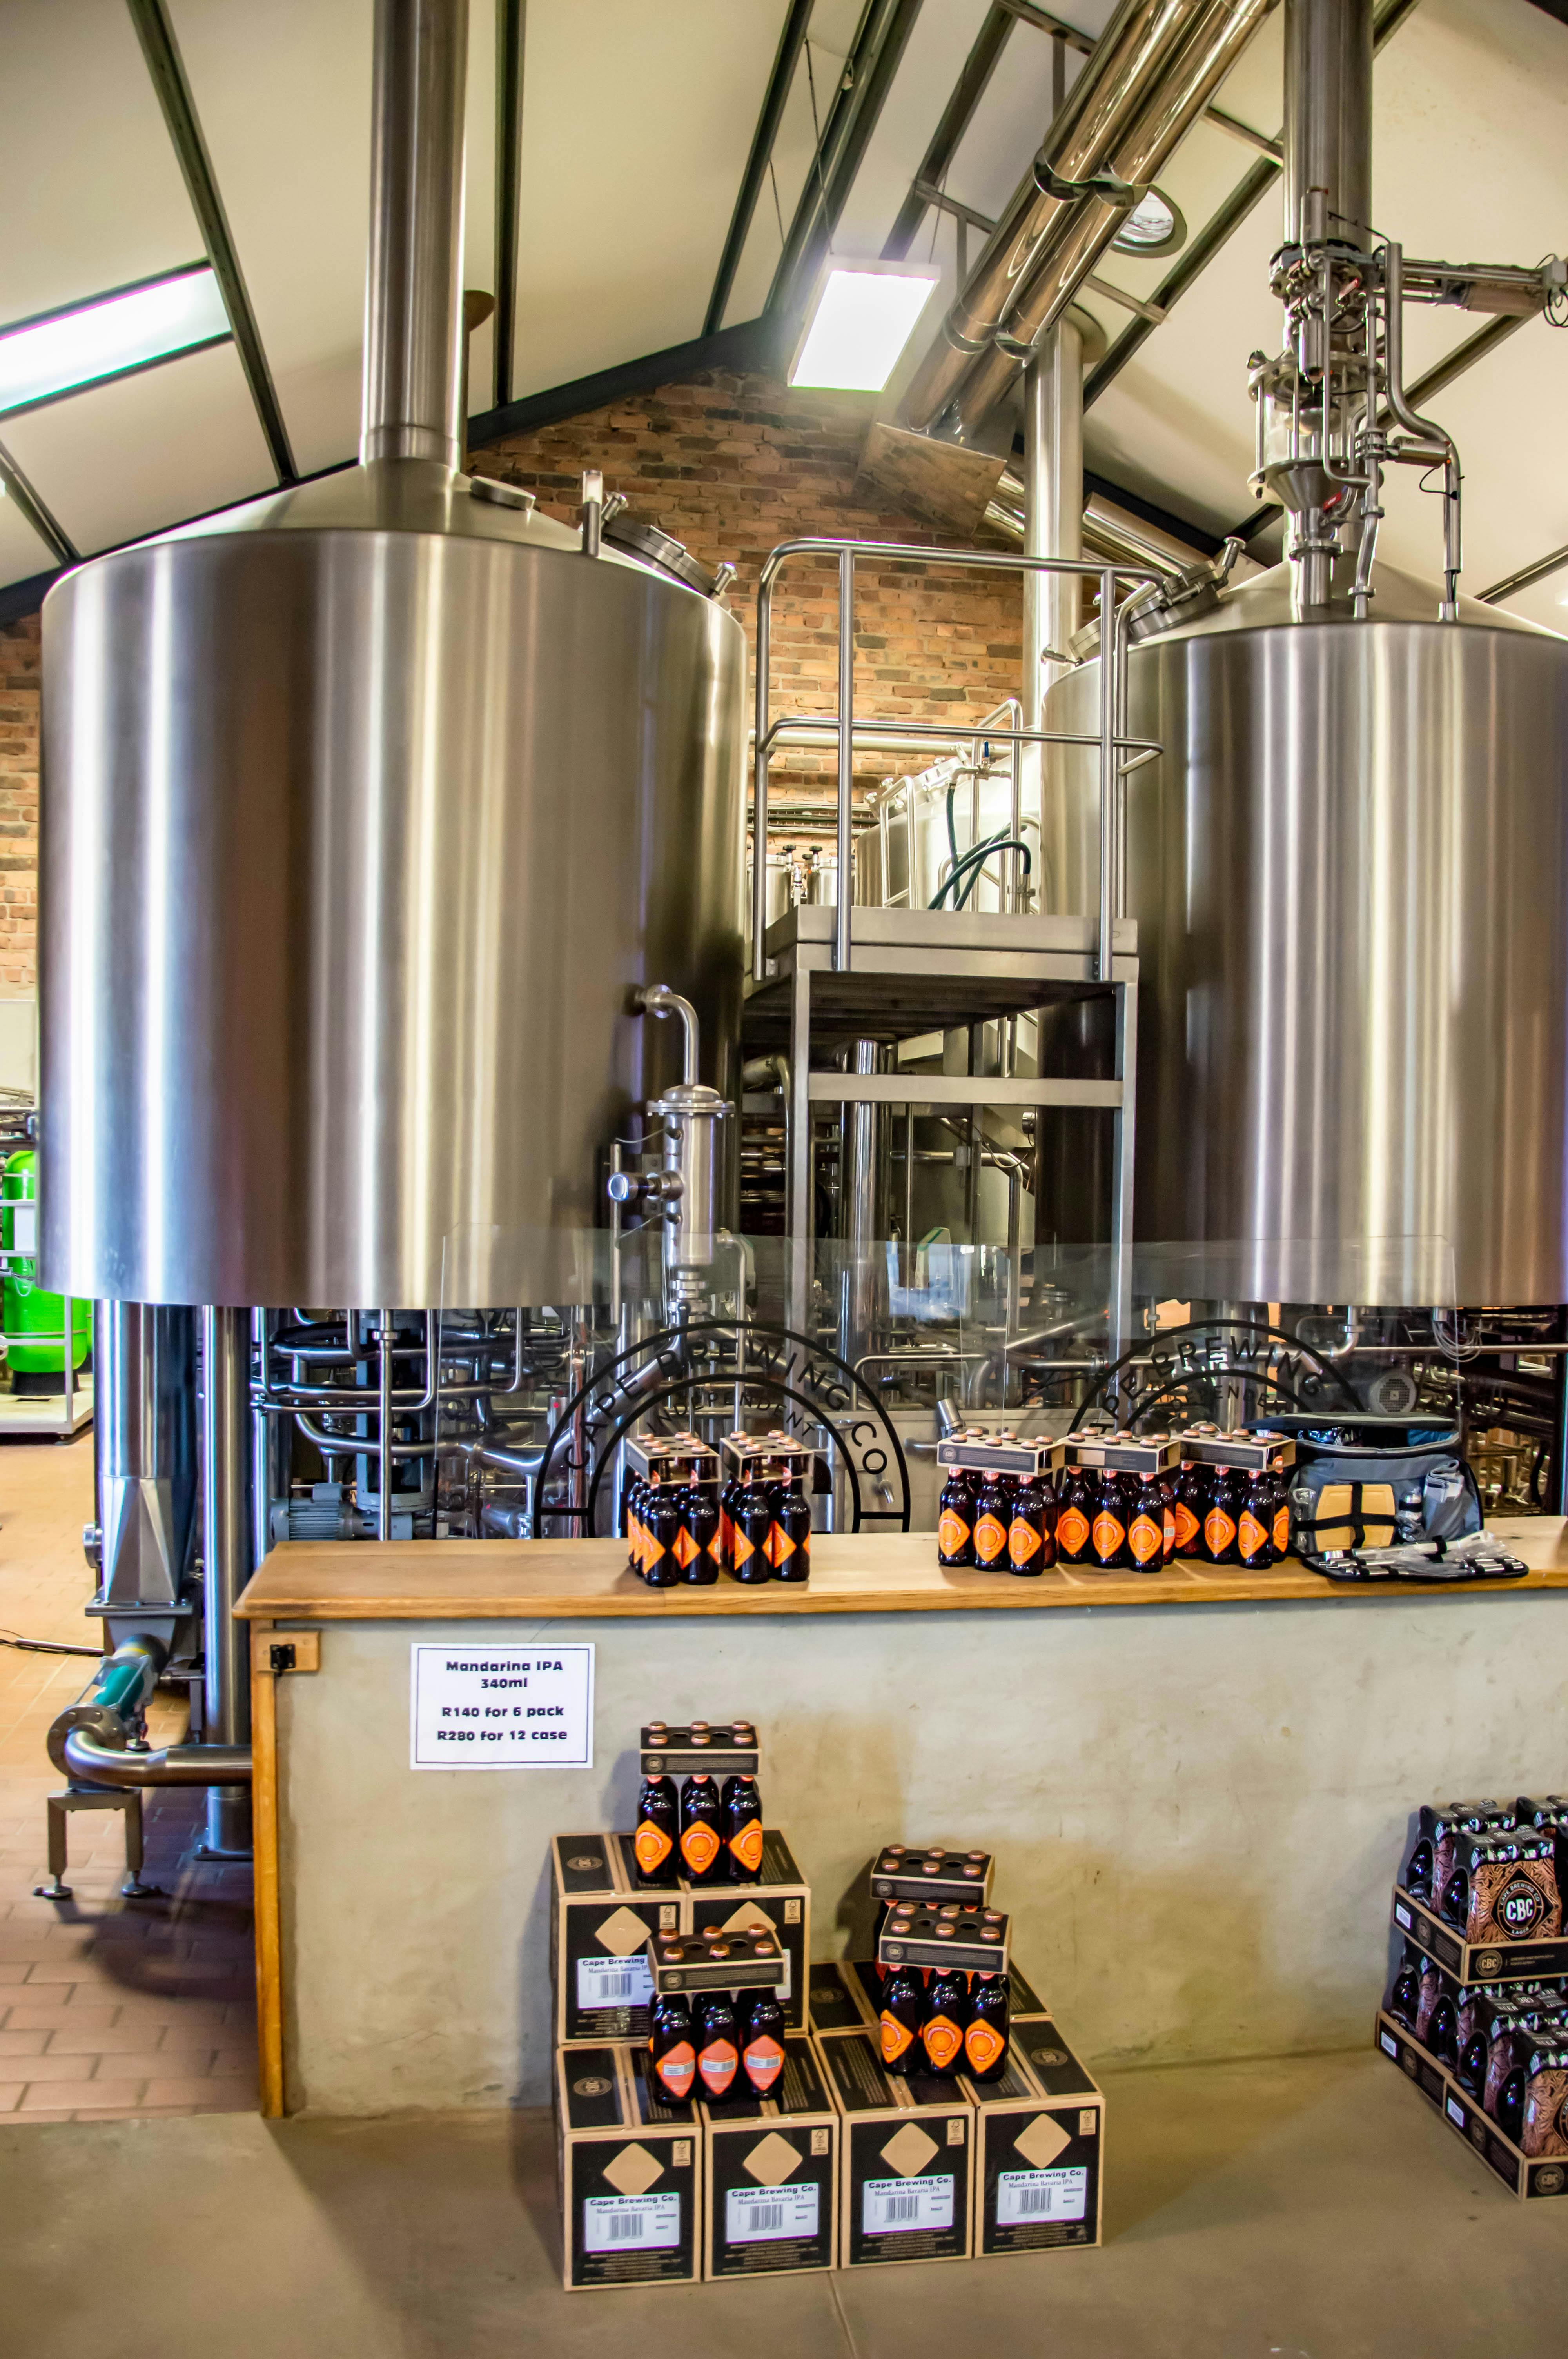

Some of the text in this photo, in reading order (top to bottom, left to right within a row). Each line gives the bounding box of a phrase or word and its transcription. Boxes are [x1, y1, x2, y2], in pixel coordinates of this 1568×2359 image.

[564, 1338, 887, 1475] CAPE BREWING CO
[446, 1661, 563, 1671] Mandarina IPA
[481, 1678, 528, 1688] 340ml
[442, 1706, 564, 1717] R140 for 6 pack
[437, 1730, 567, 1741] R280 for 12 case
[1506, 1898, 1533, 1921] CBC
[1481, 1958, 1497, 1969] CBC
[895, 2178, 933, 2186] Brewing
